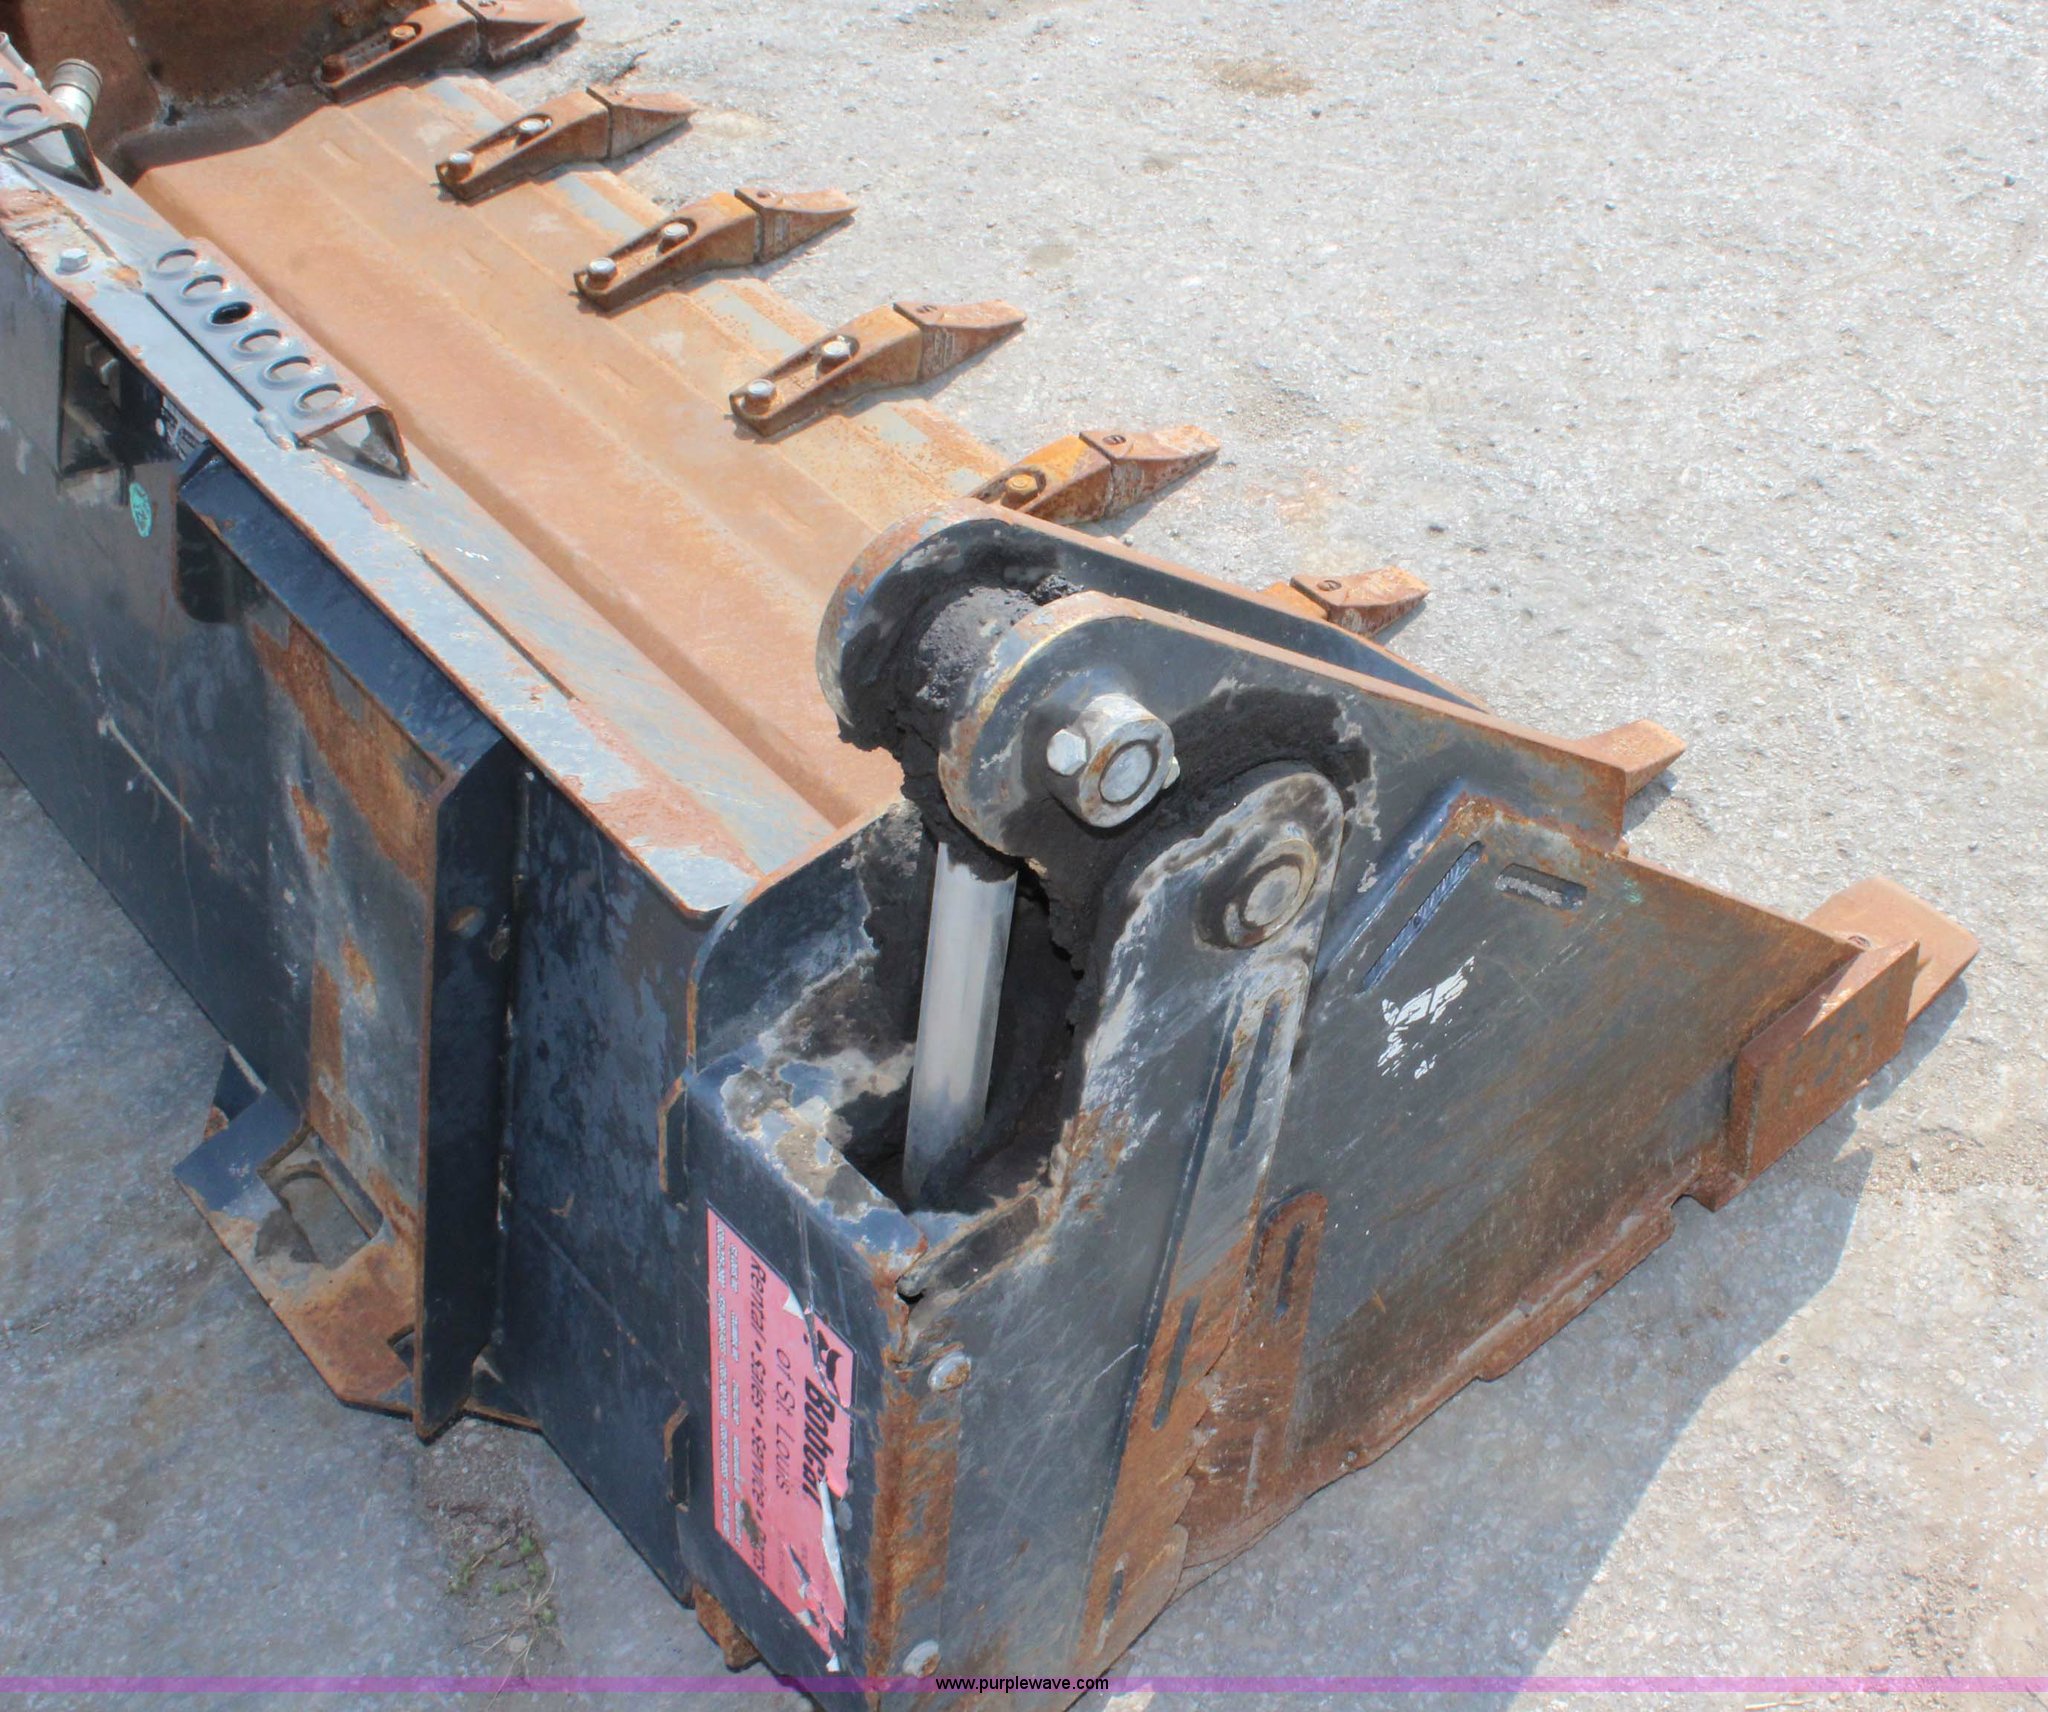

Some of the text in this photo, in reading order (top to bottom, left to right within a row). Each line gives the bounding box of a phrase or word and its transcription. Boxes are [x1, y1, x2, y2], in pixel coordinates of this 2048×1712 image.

[750, 1256, 767, 1343] Rental
[751, 1351, 767, 1415] Sales
[776, 1348, 796, 1495] of St. Louis
[752, 1427, 767, 1508] Service
[802, 1376, 836, 1508] Bobcat
